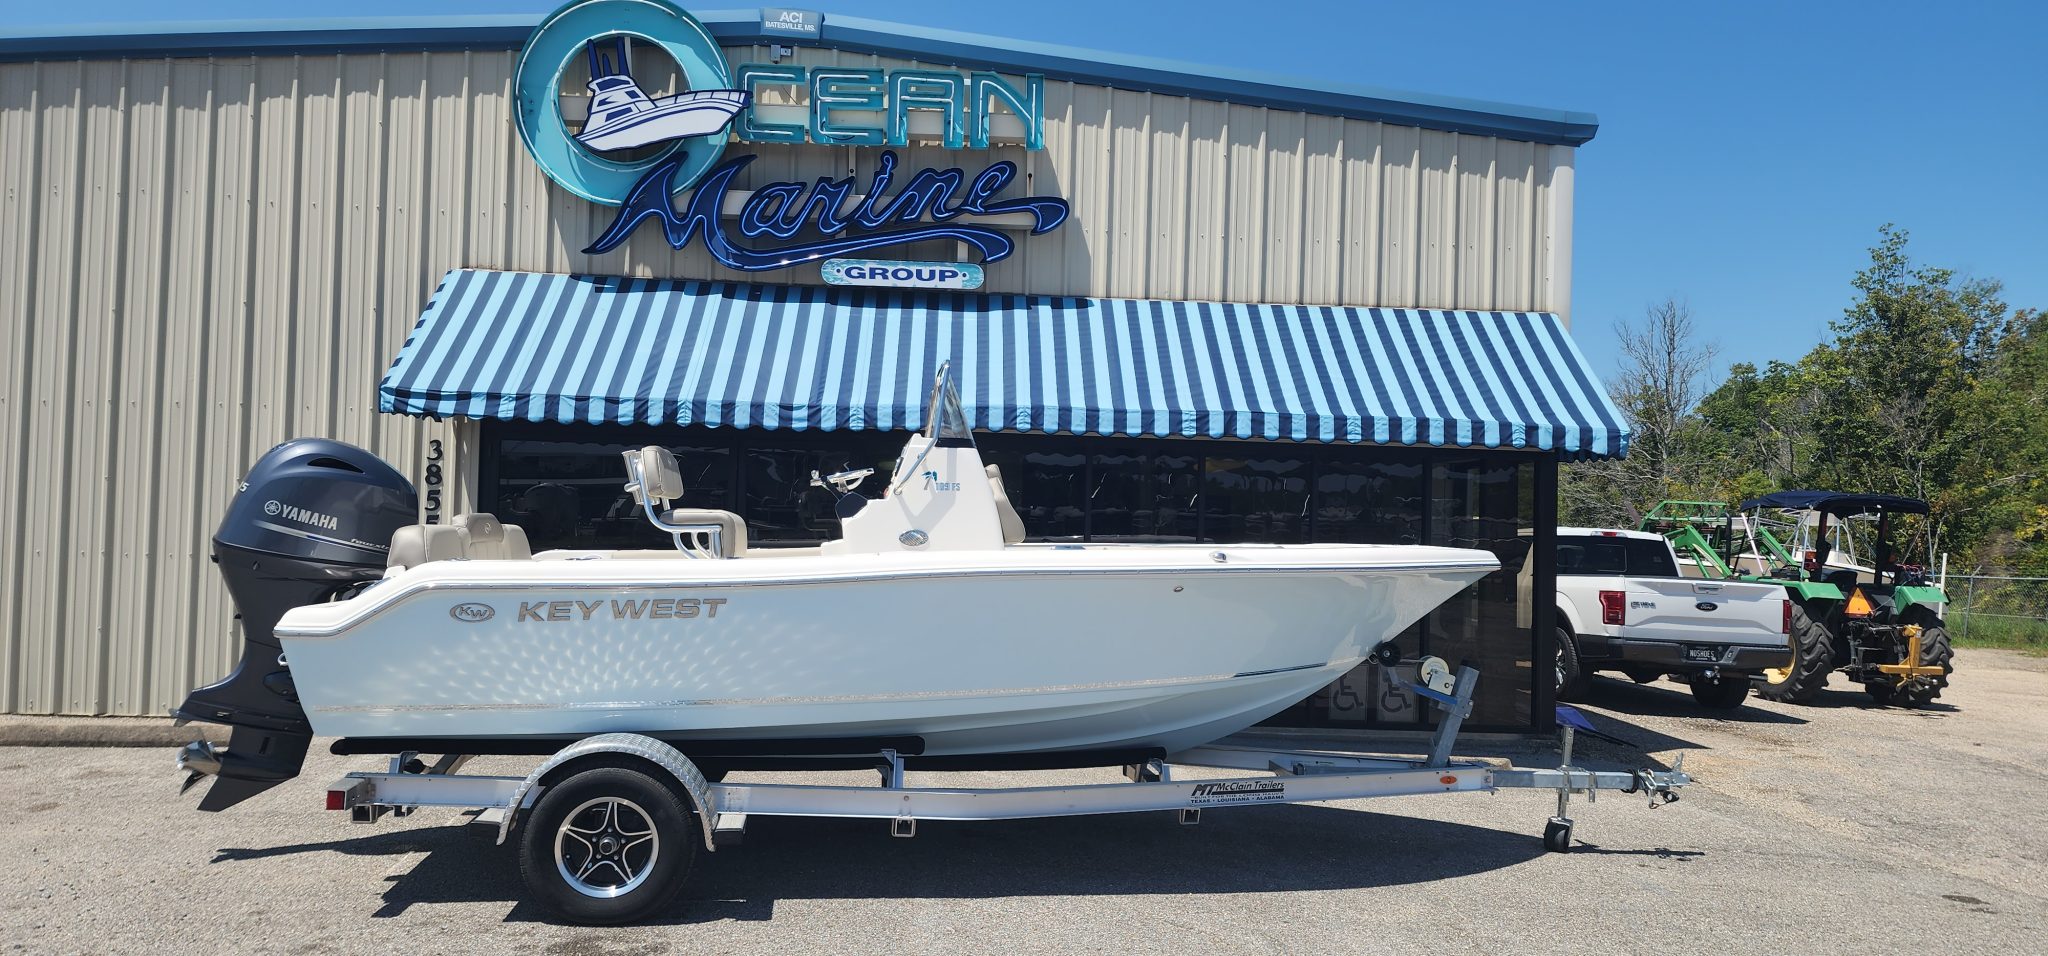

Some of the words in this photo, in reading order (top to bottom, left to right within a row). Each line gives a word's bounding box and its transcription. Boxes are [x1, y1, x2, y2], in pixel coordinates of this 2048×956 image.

[780, 11, 803, 23] ACI
[582, 150, 1070, 272] Marine
[844, 266, 959, 282] GROUP
[281, 503, 338, 531] YAMAHA
[517, 601, 604, 623] KEY
[610, 598, 728, 620] WEST
[1216, 781, 1252, 792] McClain
[1254, 780, 1285, 790] Trailers
